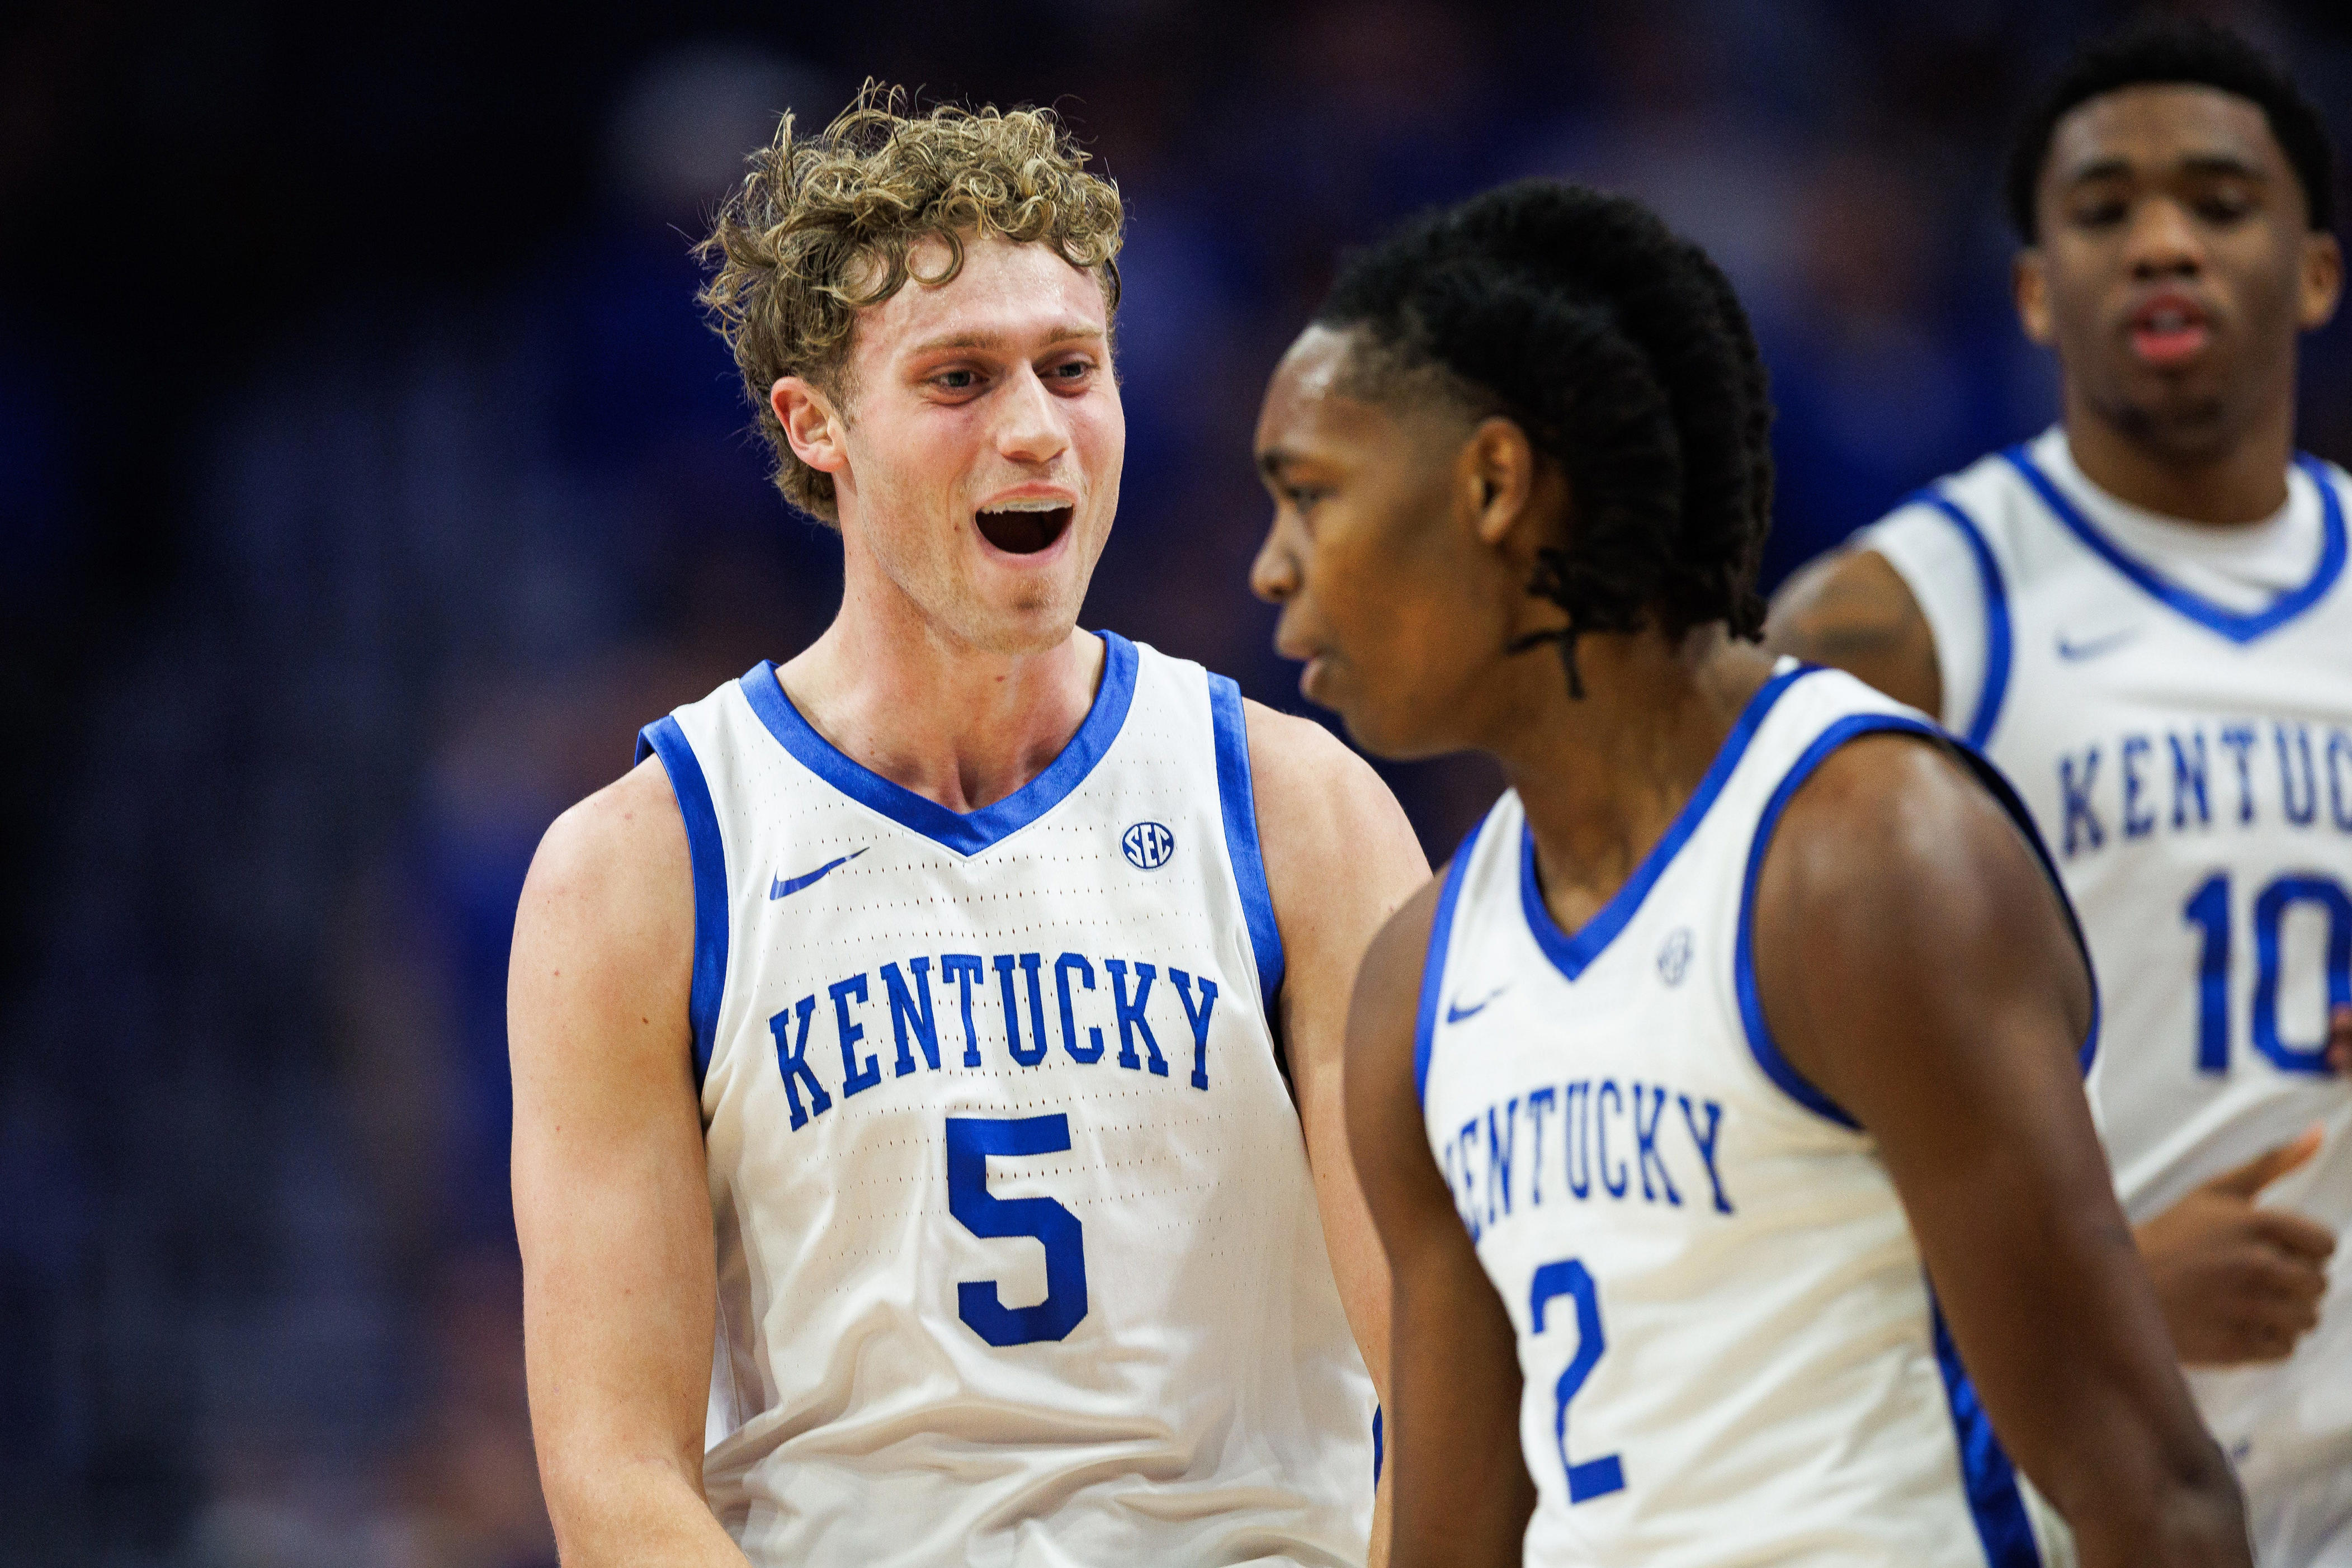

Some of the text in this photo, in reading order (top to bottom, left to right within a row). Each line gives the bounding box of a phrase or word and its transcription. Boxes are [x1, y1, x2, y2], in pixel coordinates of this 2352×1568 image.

[1125, 824, 1171, 867] SEC
[769, 952, 1218, 1132] KENTUCKY
[2184, 871, 2352, 1075] 10
[945, 1113, 1089, 1348] 5
[1444, 1079, 1735, 1245] ENTUCKY
[1530, 1257, 1626, 1504] 2
